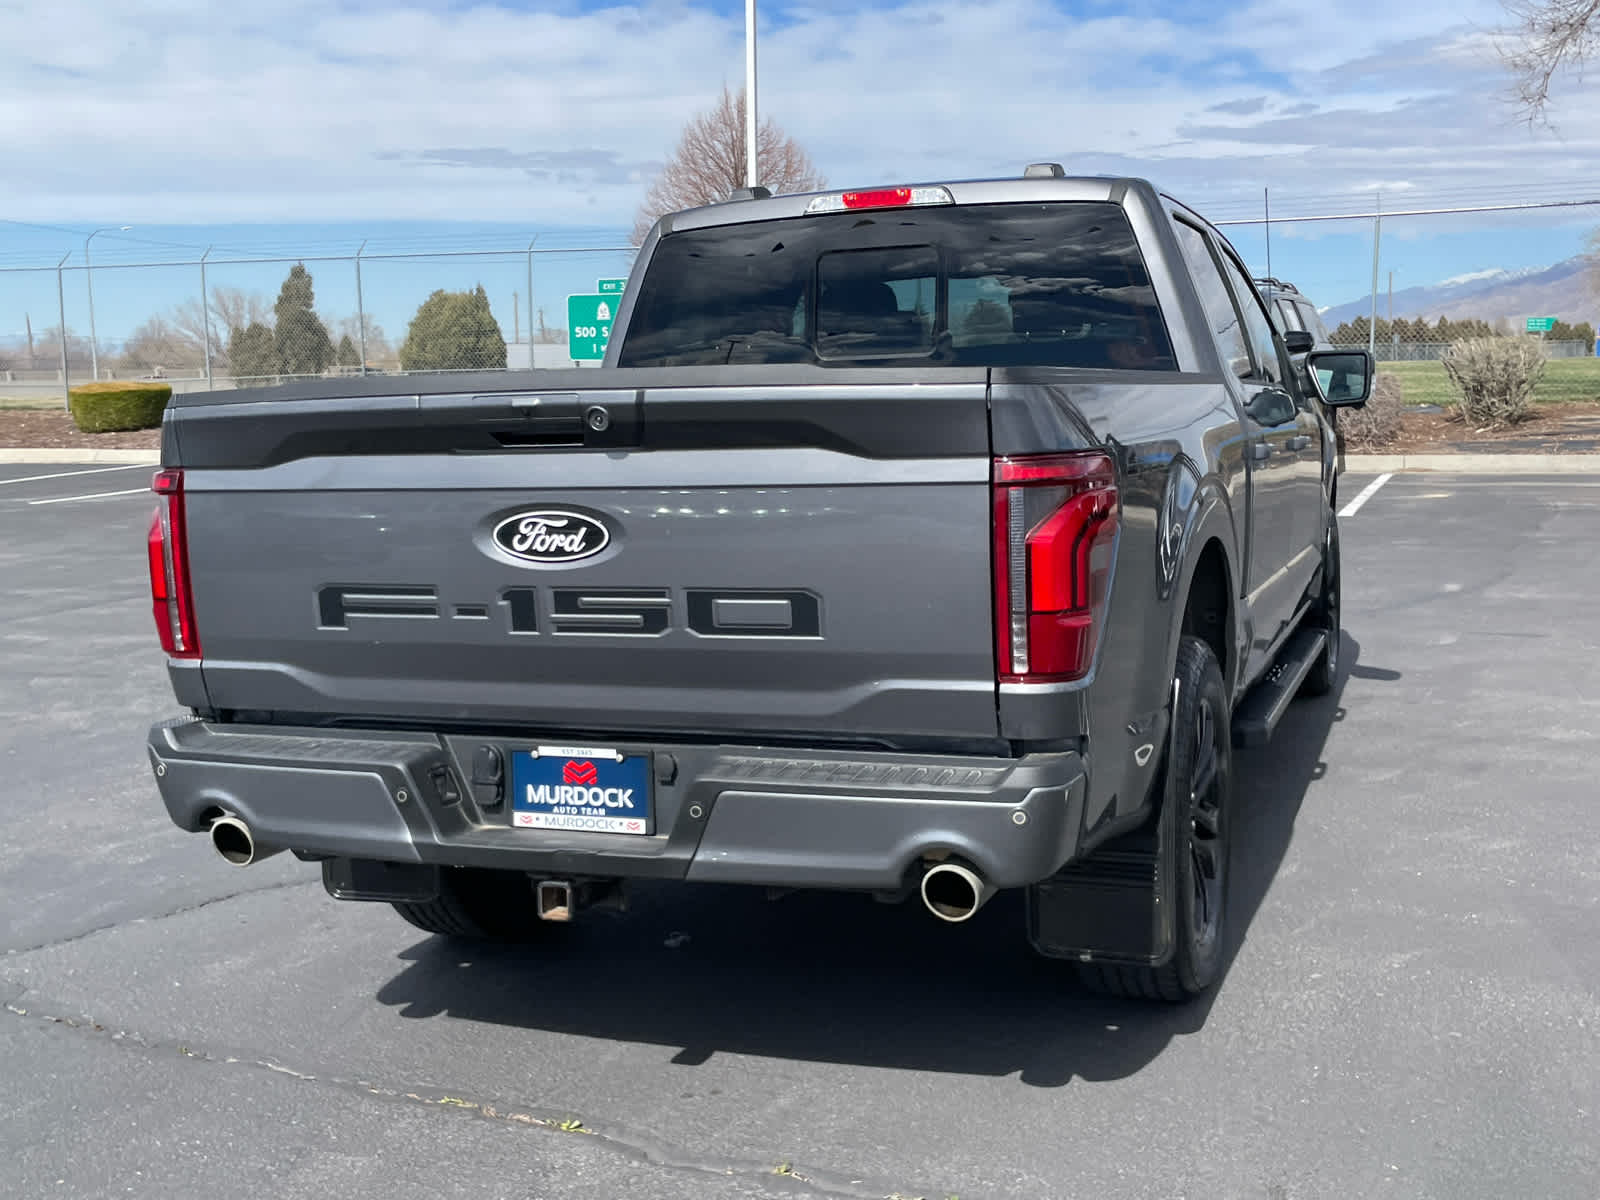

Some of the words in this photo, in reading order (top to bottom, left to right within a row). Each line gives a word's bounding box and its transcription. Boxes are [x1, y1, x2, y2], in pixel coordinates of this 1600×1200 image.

[575, 326, 596, 338] 500
[512, 518, 589, 553] Ford
[315, 582, 825, 641] F-150
[526, 783, 634, 809] MURDOCK
[552, 805, 578, 815] AUTO
[581, 807, 606, 816] TEAM
[544, 815, 616, 830] MURDOCK
